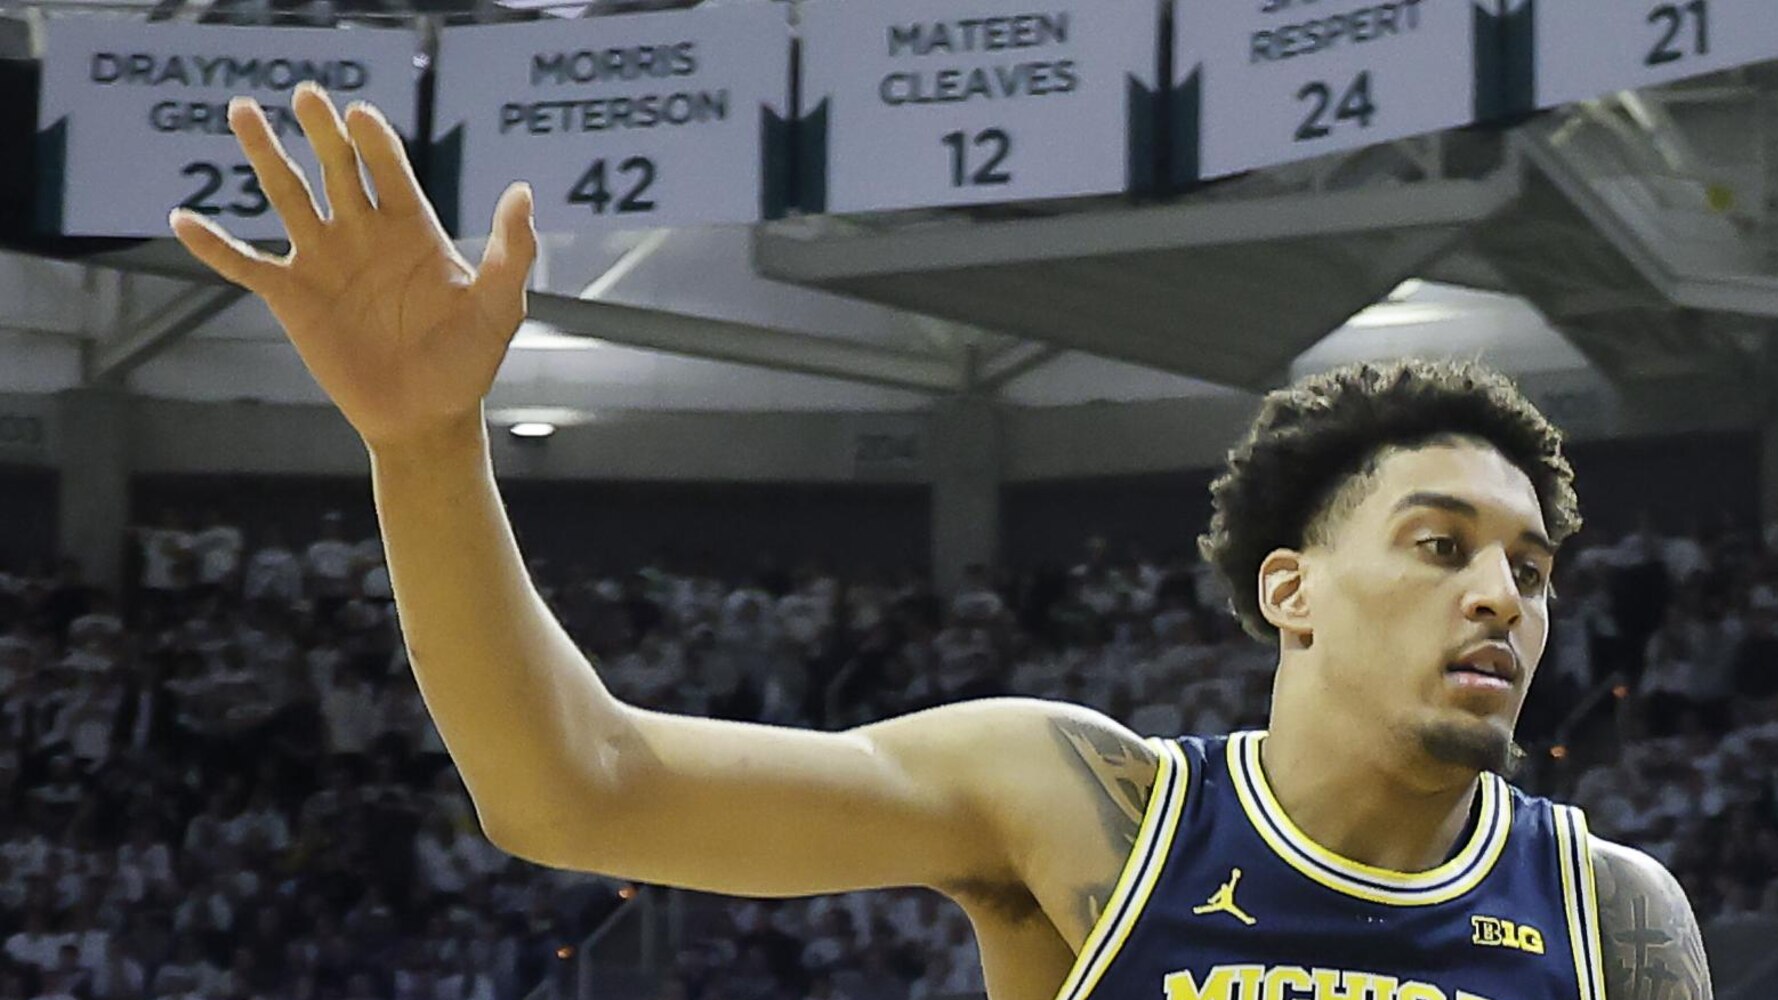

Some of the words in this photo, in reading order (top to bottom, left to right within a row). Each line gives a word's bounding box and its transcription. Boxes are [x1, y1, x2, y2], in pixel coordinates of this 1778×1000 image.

[888, 12, 1070, 57] MATEEN
[1250, 0, 1421, 63] RESPERT
[1643, 0, 1710, 66] 21
[91, 53, 370, 92] DRAYMOND
[530, 41, 698, 86] MORRIS
[879, 60, 1078, 106] CLEAVES
[499, 88, 729, 135] PETERSON
[1294, 69, 1376, 142] 24
[567, 155, 656, 214] 42
[941, 127, 1011, 187] 12
[179, 161, 270, 218] 23
